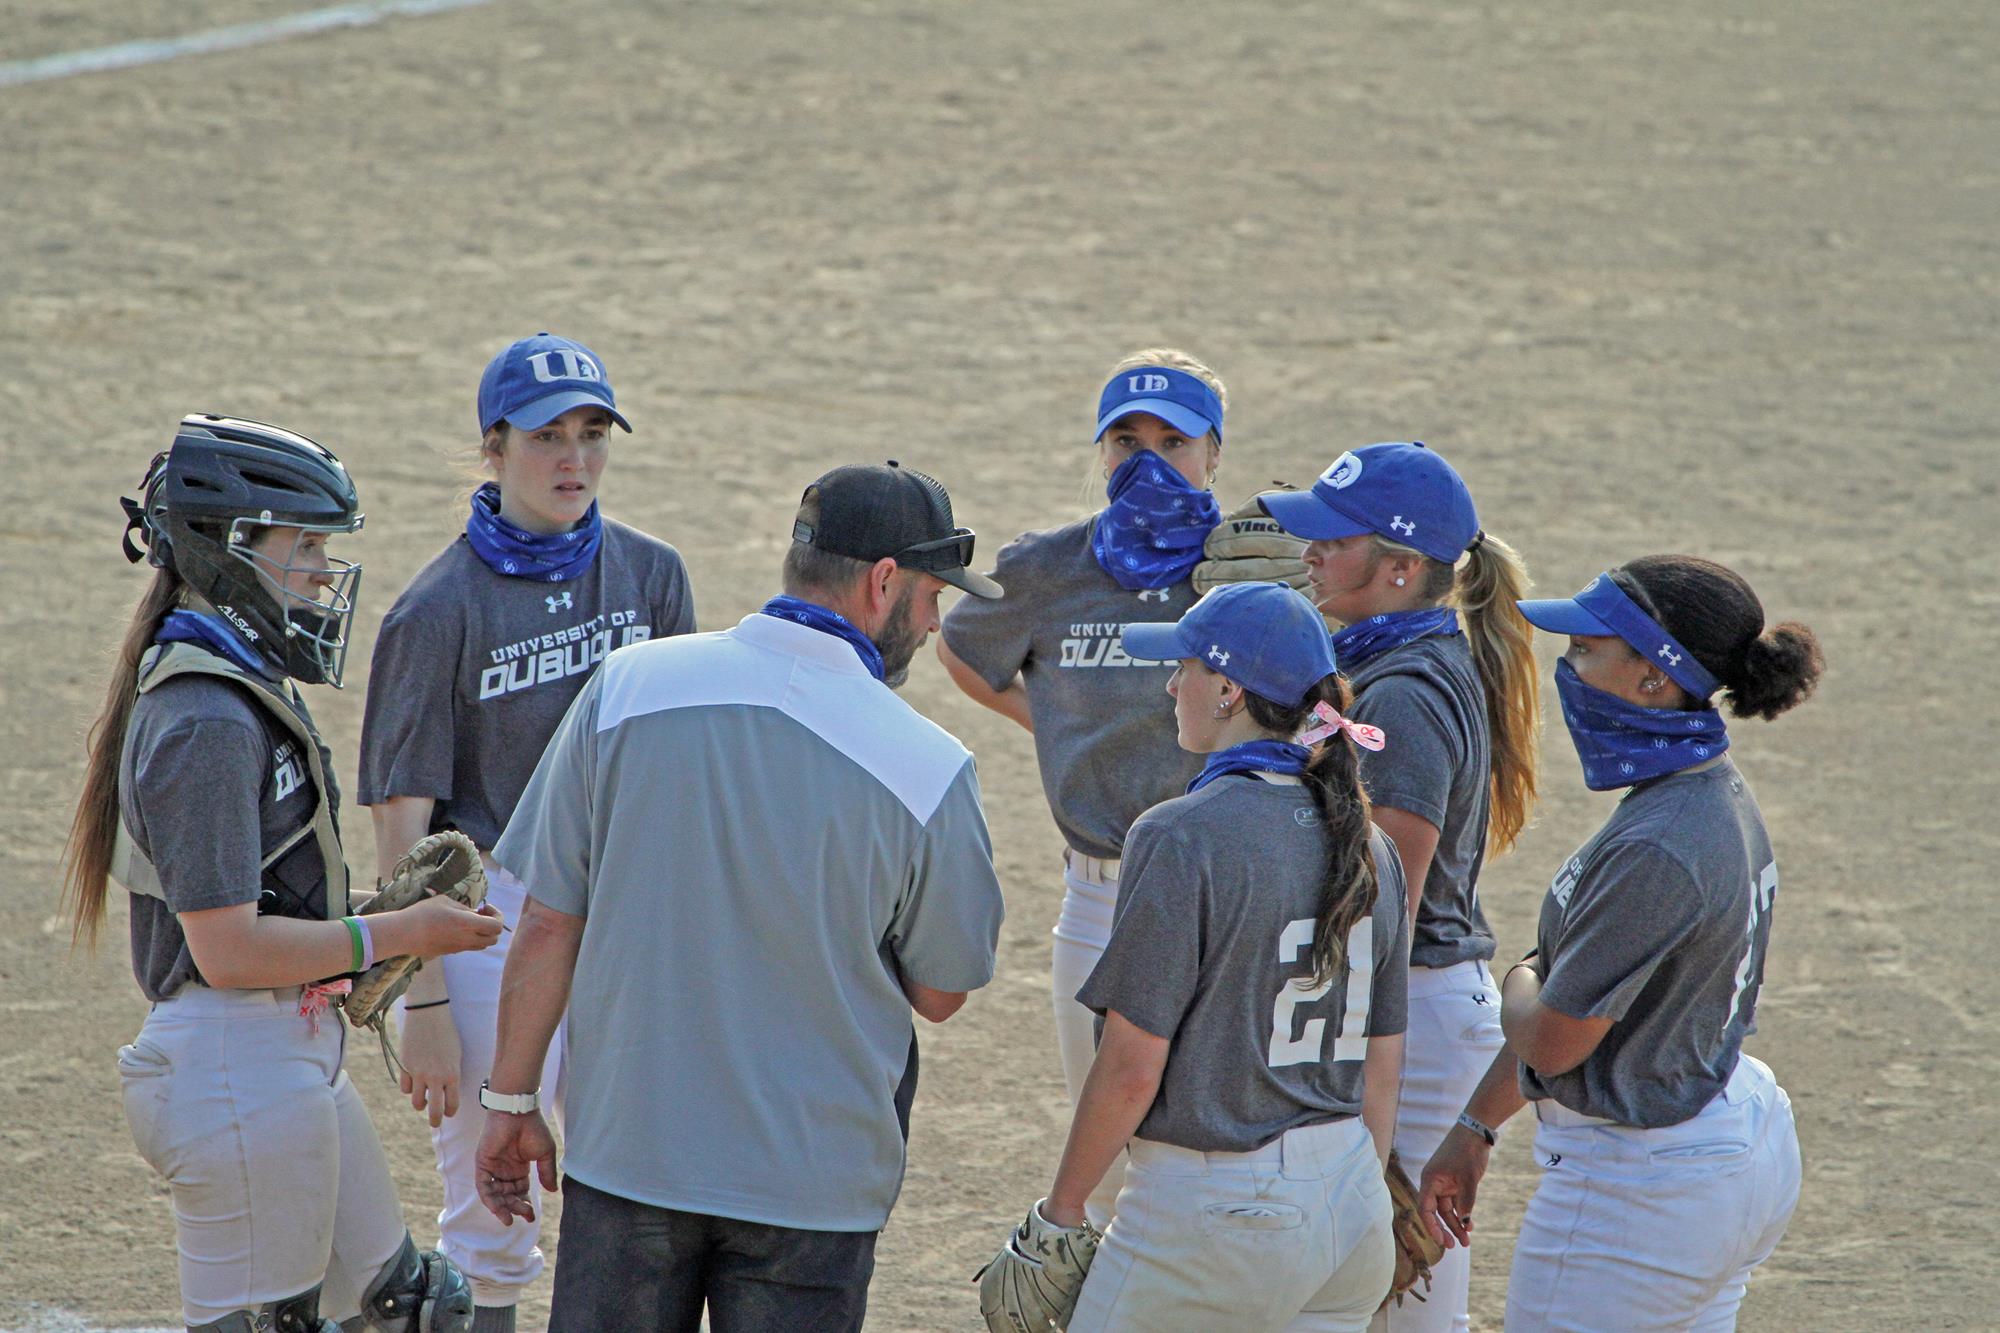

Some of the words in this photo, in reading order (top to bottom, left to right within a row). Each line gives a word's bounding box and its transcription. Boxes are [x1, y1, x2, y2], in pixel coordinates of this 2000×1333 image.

[217, 605, 259, 642] ALL-STAR
[610, 610, 637, 627] OF
[1059, 638, 1182, 668] DUB
[1268, 915, 1374, 1068] 21
